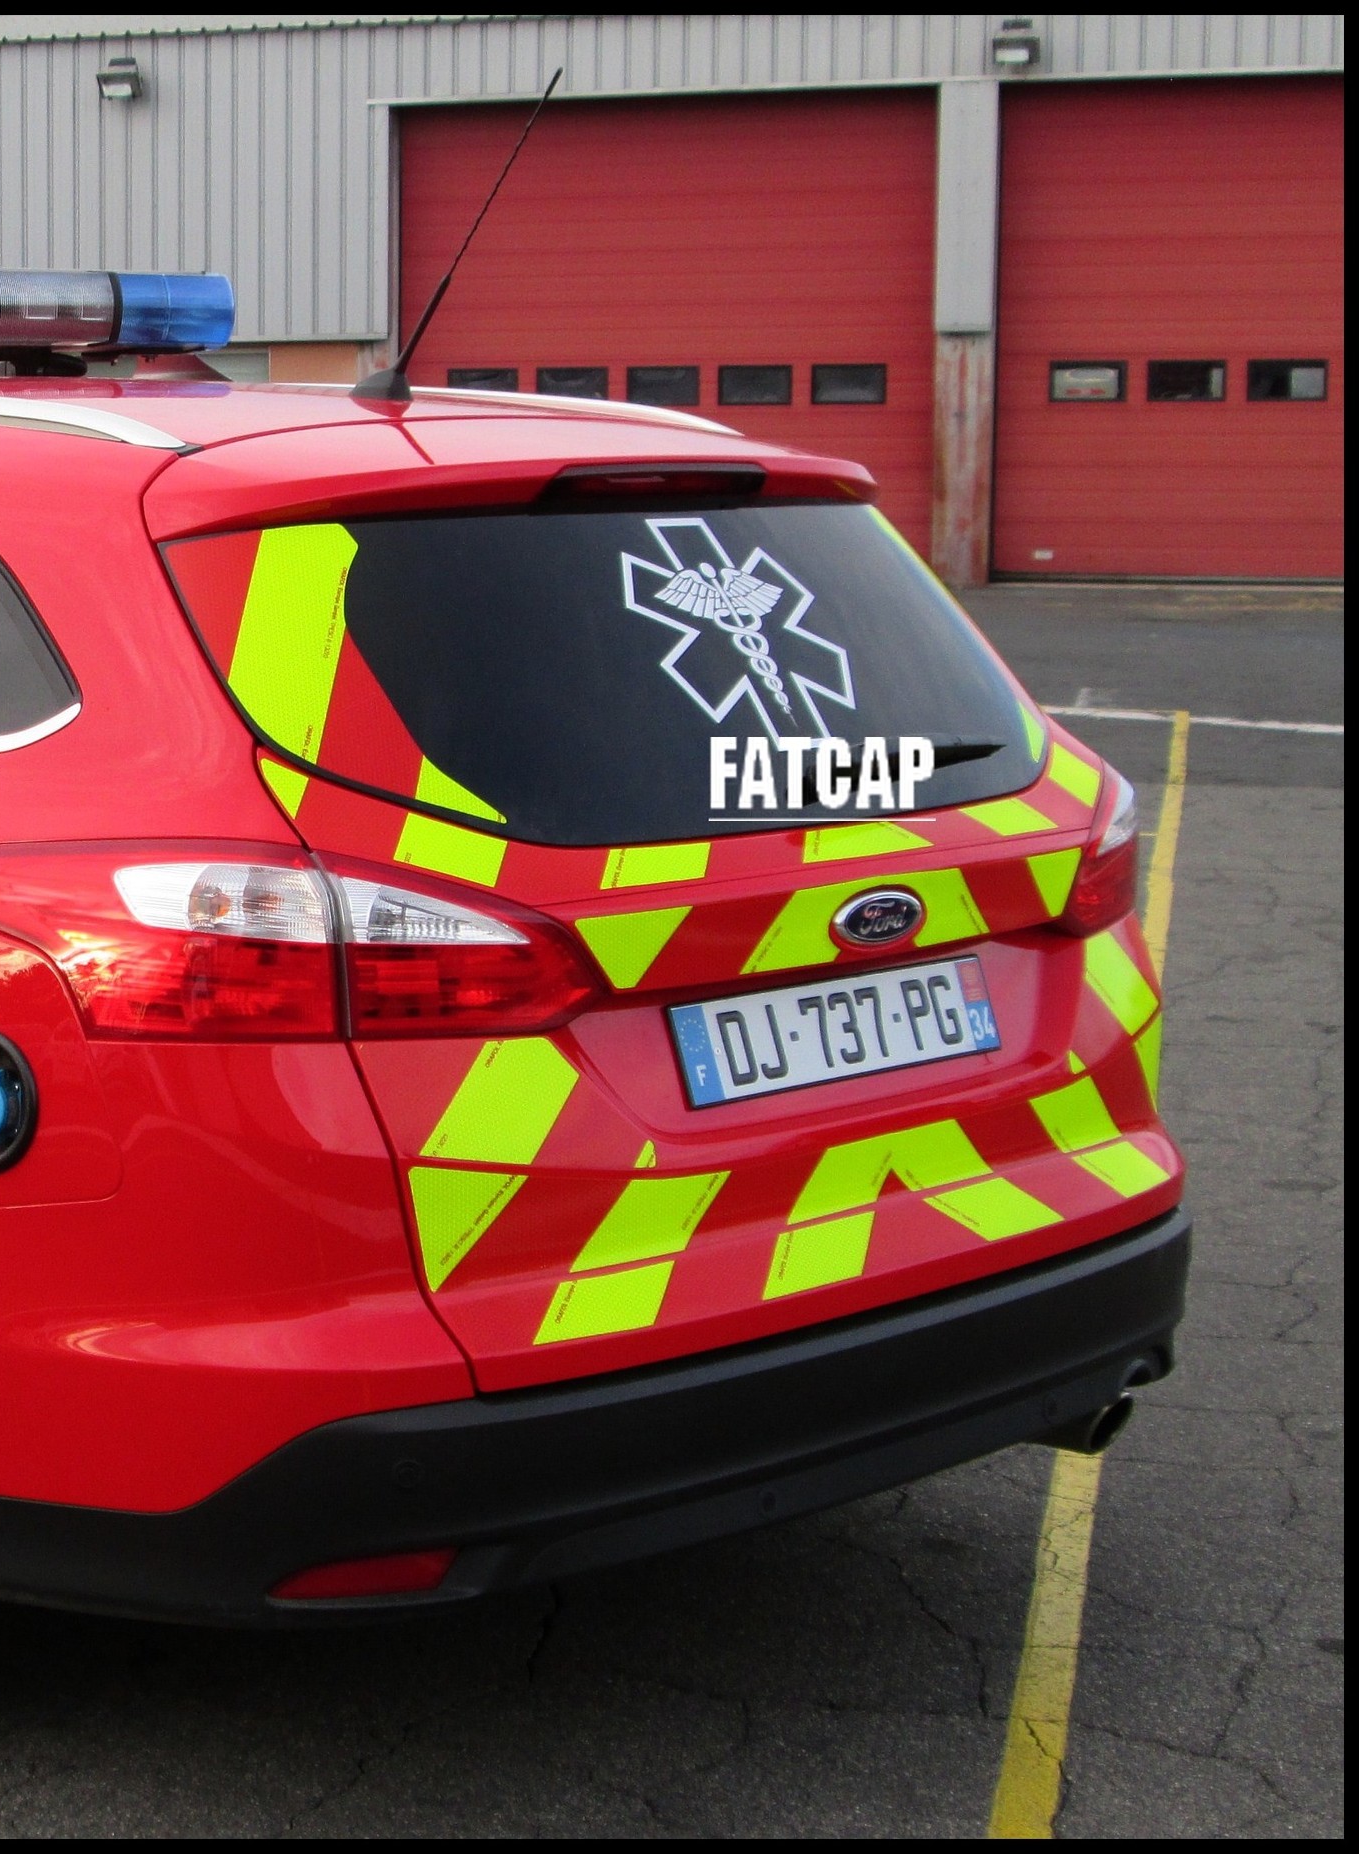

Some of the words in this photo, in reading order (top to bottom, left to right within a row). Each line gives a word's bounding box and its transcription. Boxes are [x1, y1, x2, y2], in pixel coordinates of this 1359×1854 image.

[859, 901, 908, 935] Ford
[969, 1006, 995, 1042] 34
[695, 1064, 707, 1087] F
